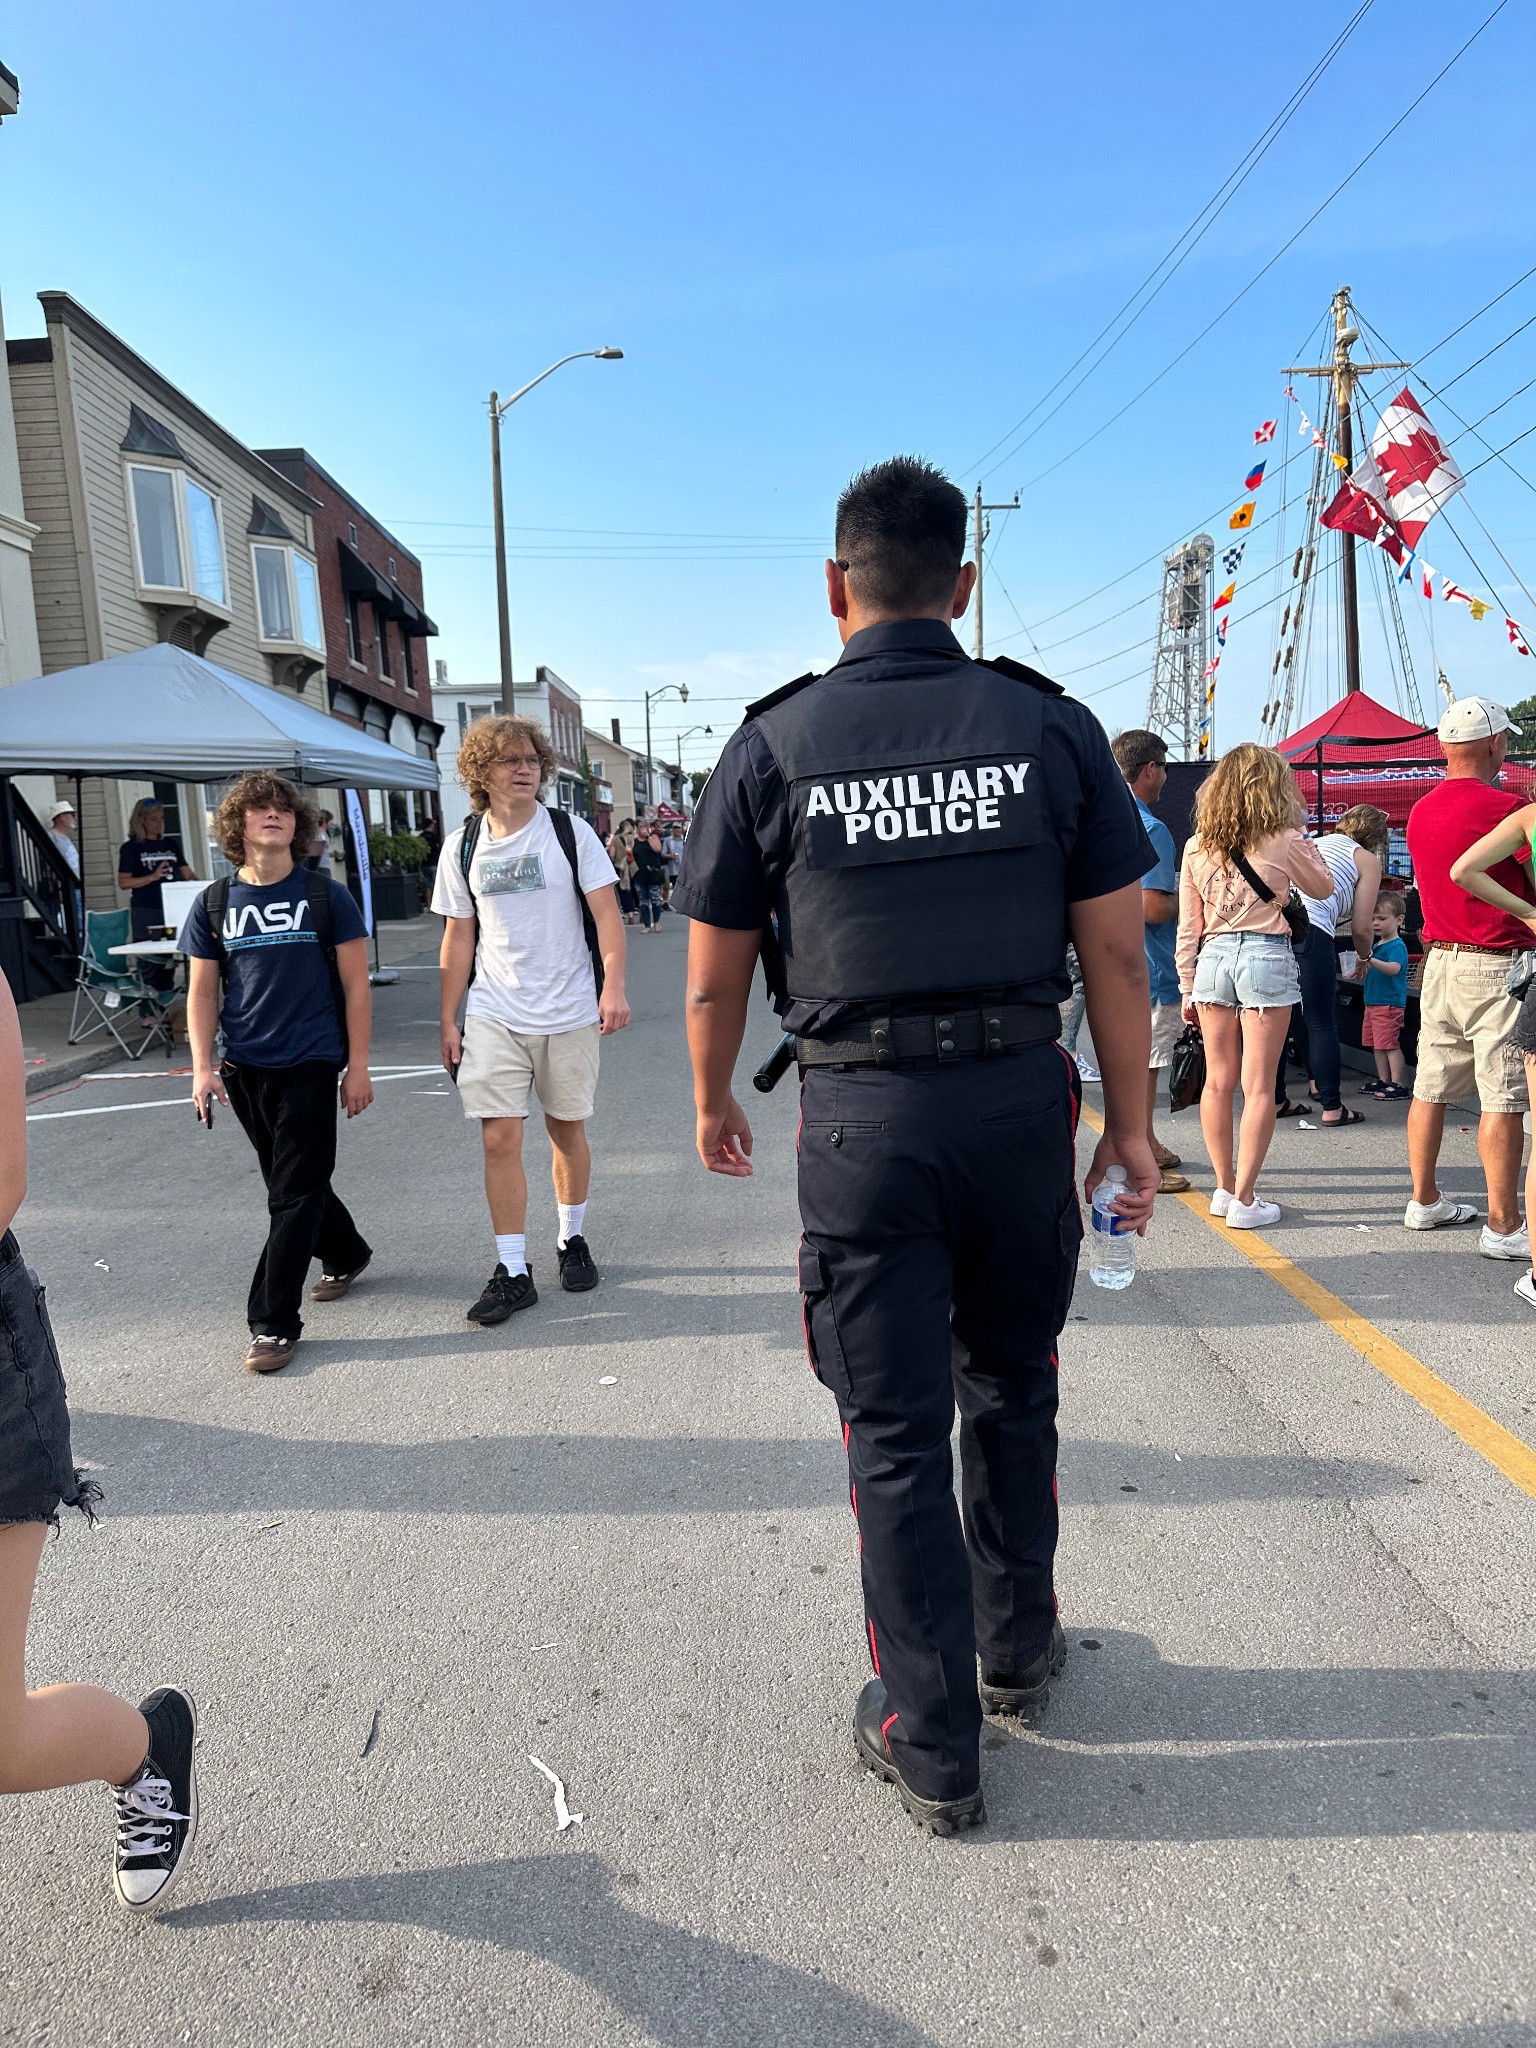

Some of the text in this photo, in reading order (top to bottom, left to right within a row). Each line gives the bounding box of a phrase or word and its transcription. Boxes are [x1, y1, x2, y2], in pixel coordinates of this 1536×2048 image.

[806, 763, 1030, 817] AUXILIARY
[844, 798, 1001, 844] POLICE
[1215, 871, 1246, 882] SALT
